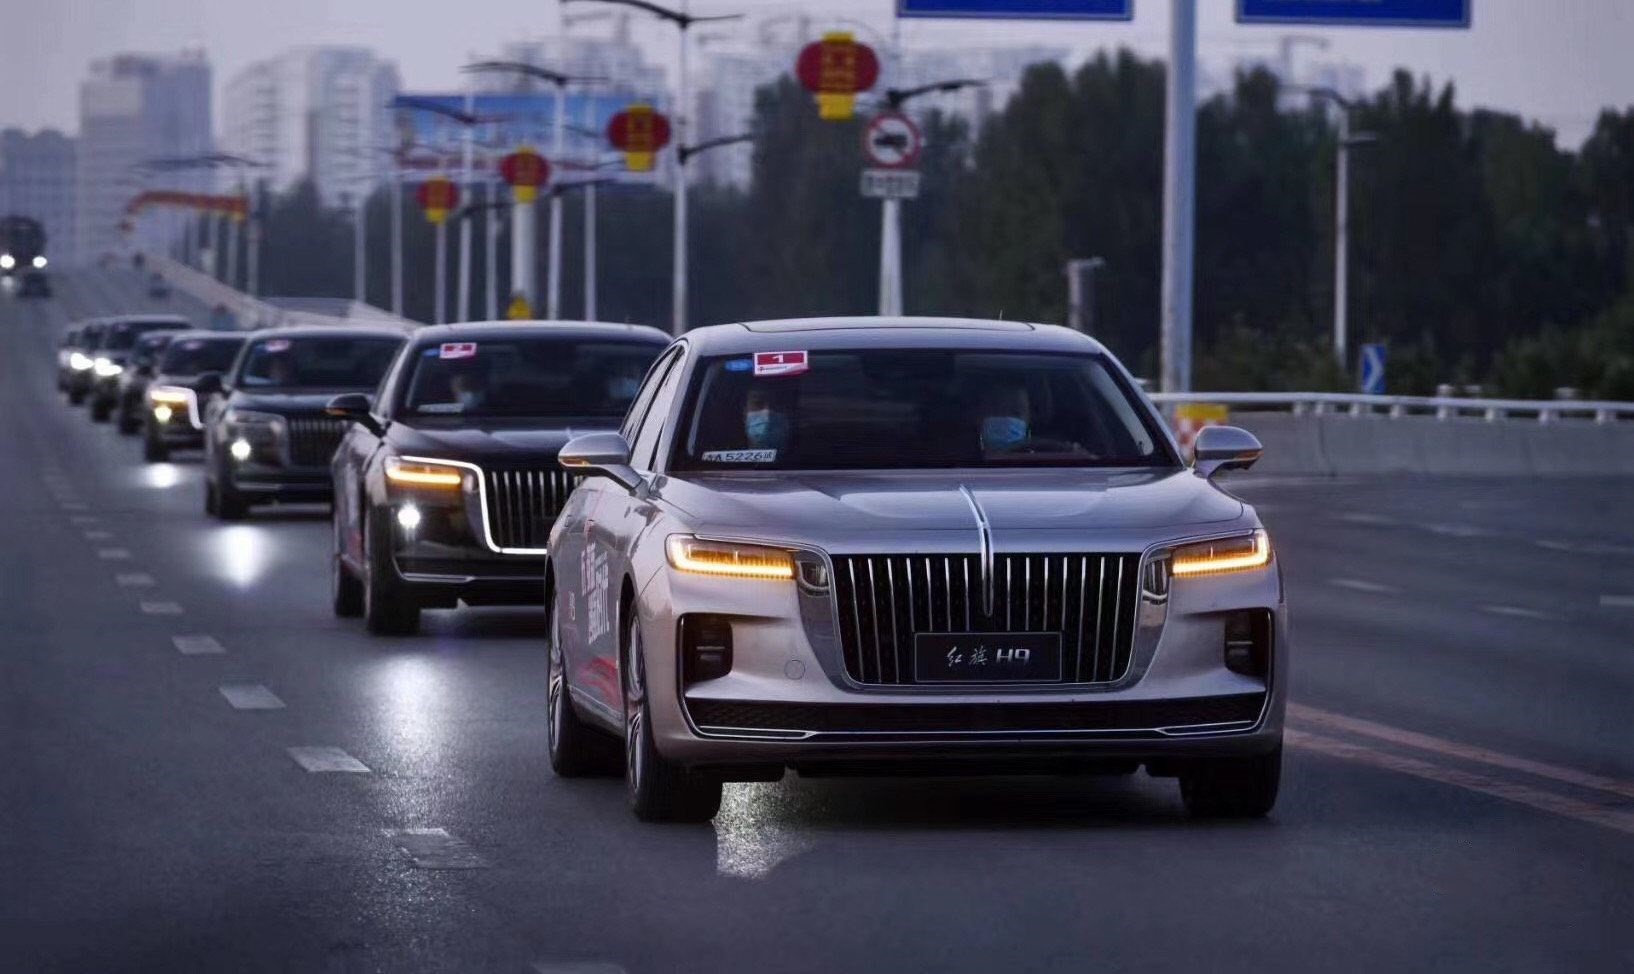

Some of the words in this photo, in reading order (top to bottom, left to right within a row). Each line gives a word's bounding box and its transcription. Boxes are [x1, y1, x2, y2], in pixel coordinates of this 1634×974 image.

[772, 354, 784, 363] 1
[946, 645, 988, 667] 红旗
[996, 648, 1031, 665] H9
